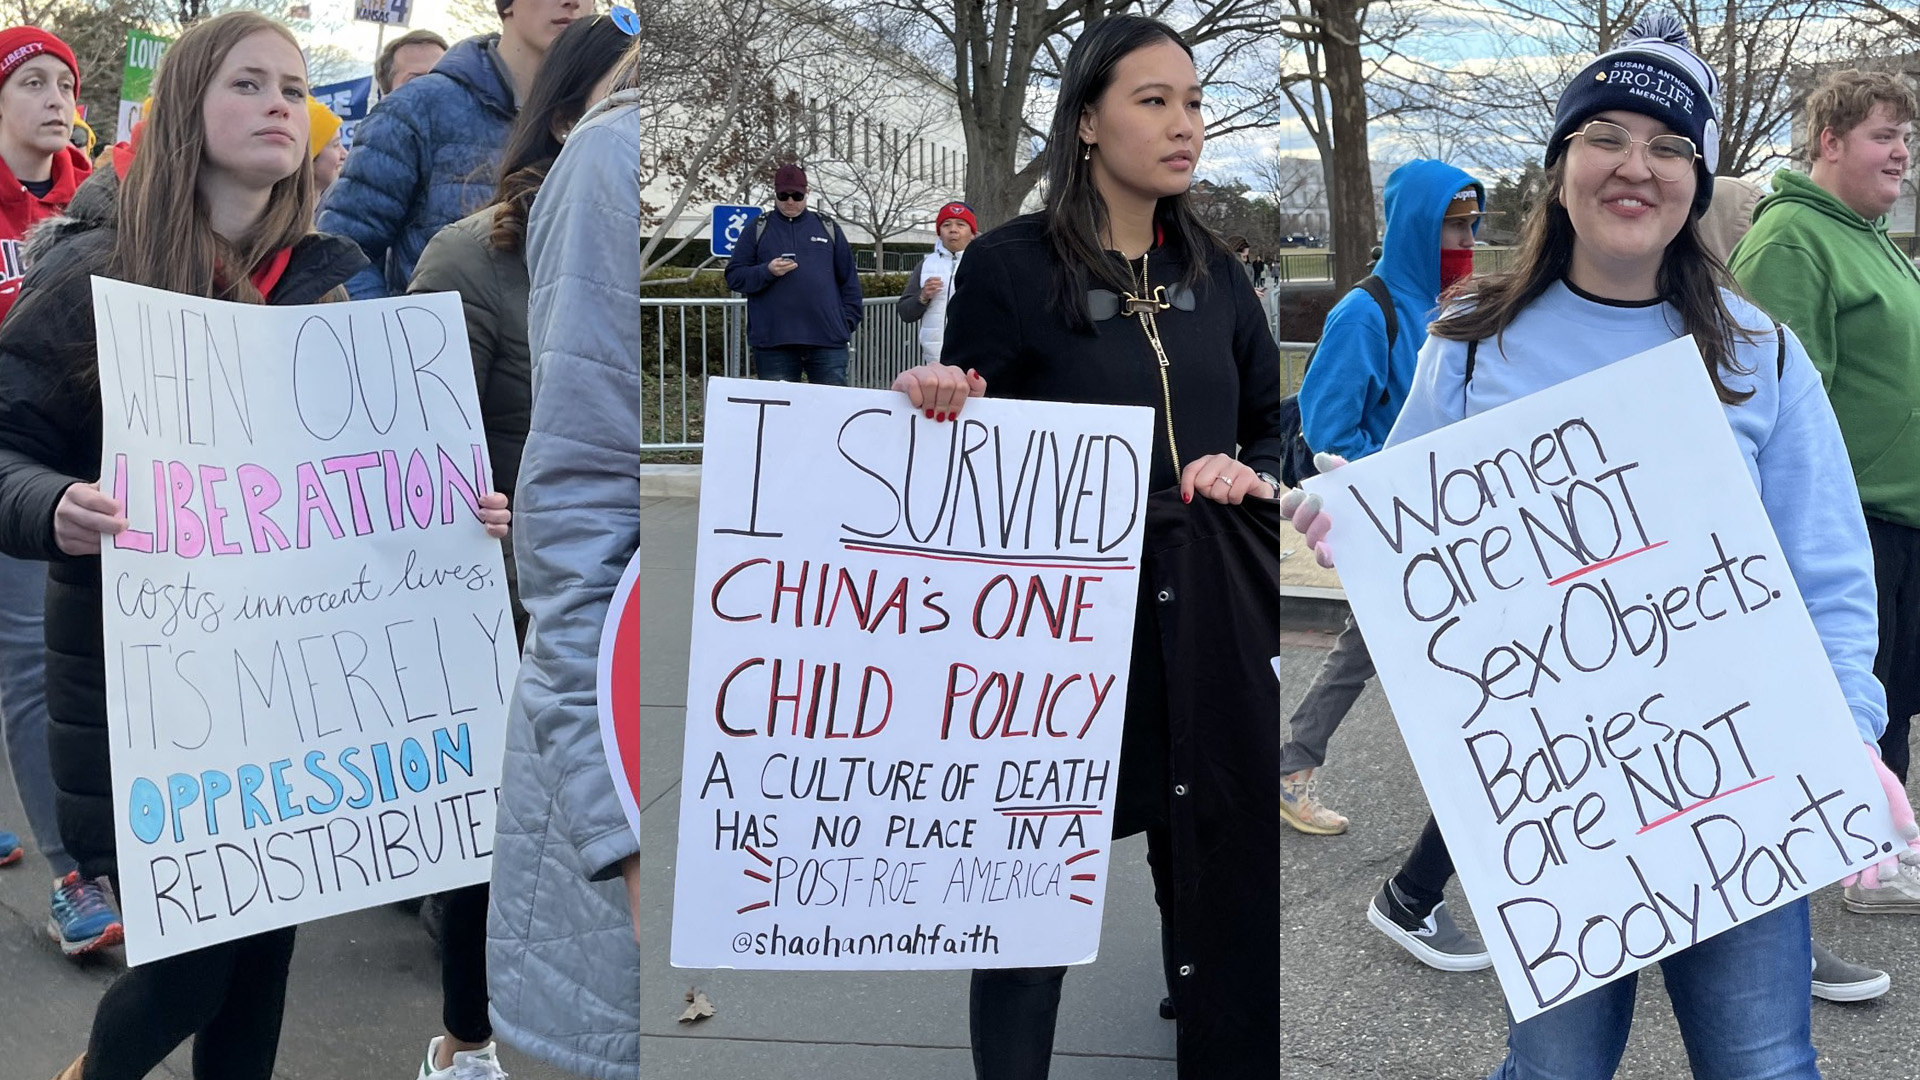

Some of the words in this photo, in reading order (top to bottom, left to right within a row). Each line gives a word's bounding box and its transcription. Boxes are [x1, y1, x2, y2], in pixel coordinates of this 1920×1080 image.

[0, 42, 44, 71] LIBERTY
[356, 7, 390, 23] KANSAS
[1607, 70, 1695, 115] PRO-LIFE
[1614, 61, 1645, 70] SUSAN
[1658, 69, 1695, 97] ANTHONY
[1629, 87, 1671, 109] AMERICA
[1453, 190, 1477, 201] Supre
[105, 294, 253, 447] WHEN
[293, 306, 472, 441] OUR
[112, 444, 488, 559] LIBERATION
[714, 396, 791, 538] I
[837, 408, 1140, 554] SURVIVED
[1348, 417, 1608, 554] Women
[1403, 525, 1525, 622] are
[1518, 461, 1650, 580] NOT
[234, 564, 382, 621] innocent
[972, 574, 1104, 642] ONE
[1427, 616, 1561, 729] Sex
[1559, 532, 1782, 673] Objects.
[120, 641, 213, 750] IT'S
[234, 609, 505, 747] MERELY
[715, 657, 893, 739] CHILD
[941, 662, 1116, 740] POLICY
[129, 722, 474, 844] OPPRESSION
[700, 751, 735, 800] A
[760, 753, 934, 801] CULTURE
[941, 762, 980, 802] OF
[994, 758, 1111, 802] DEATH
[1464, 693, 1675, 825] Babies
[1503, 791, 1617, 886] are
[1620, 701, 1757, 827] NOT
[150, 786, 501, 936] REDISTRIBUTE
[715, 808, 779, 851] HAS
[812, 815, 861, 849] NO
[885, 815, 978, 849] PLACE
[1007, 814, 1048, 851] IN
[1058, 814, 1087, 849] A
[773, 857, 927, 907] POST-ROE
[942, 857, 1061, 904] AMERICA
[1497, 855, 1701, 1009] Body
[1691, 774, 1893, 923] Parts.
[732, 924, 1000, 957] @shaohannahfaith
